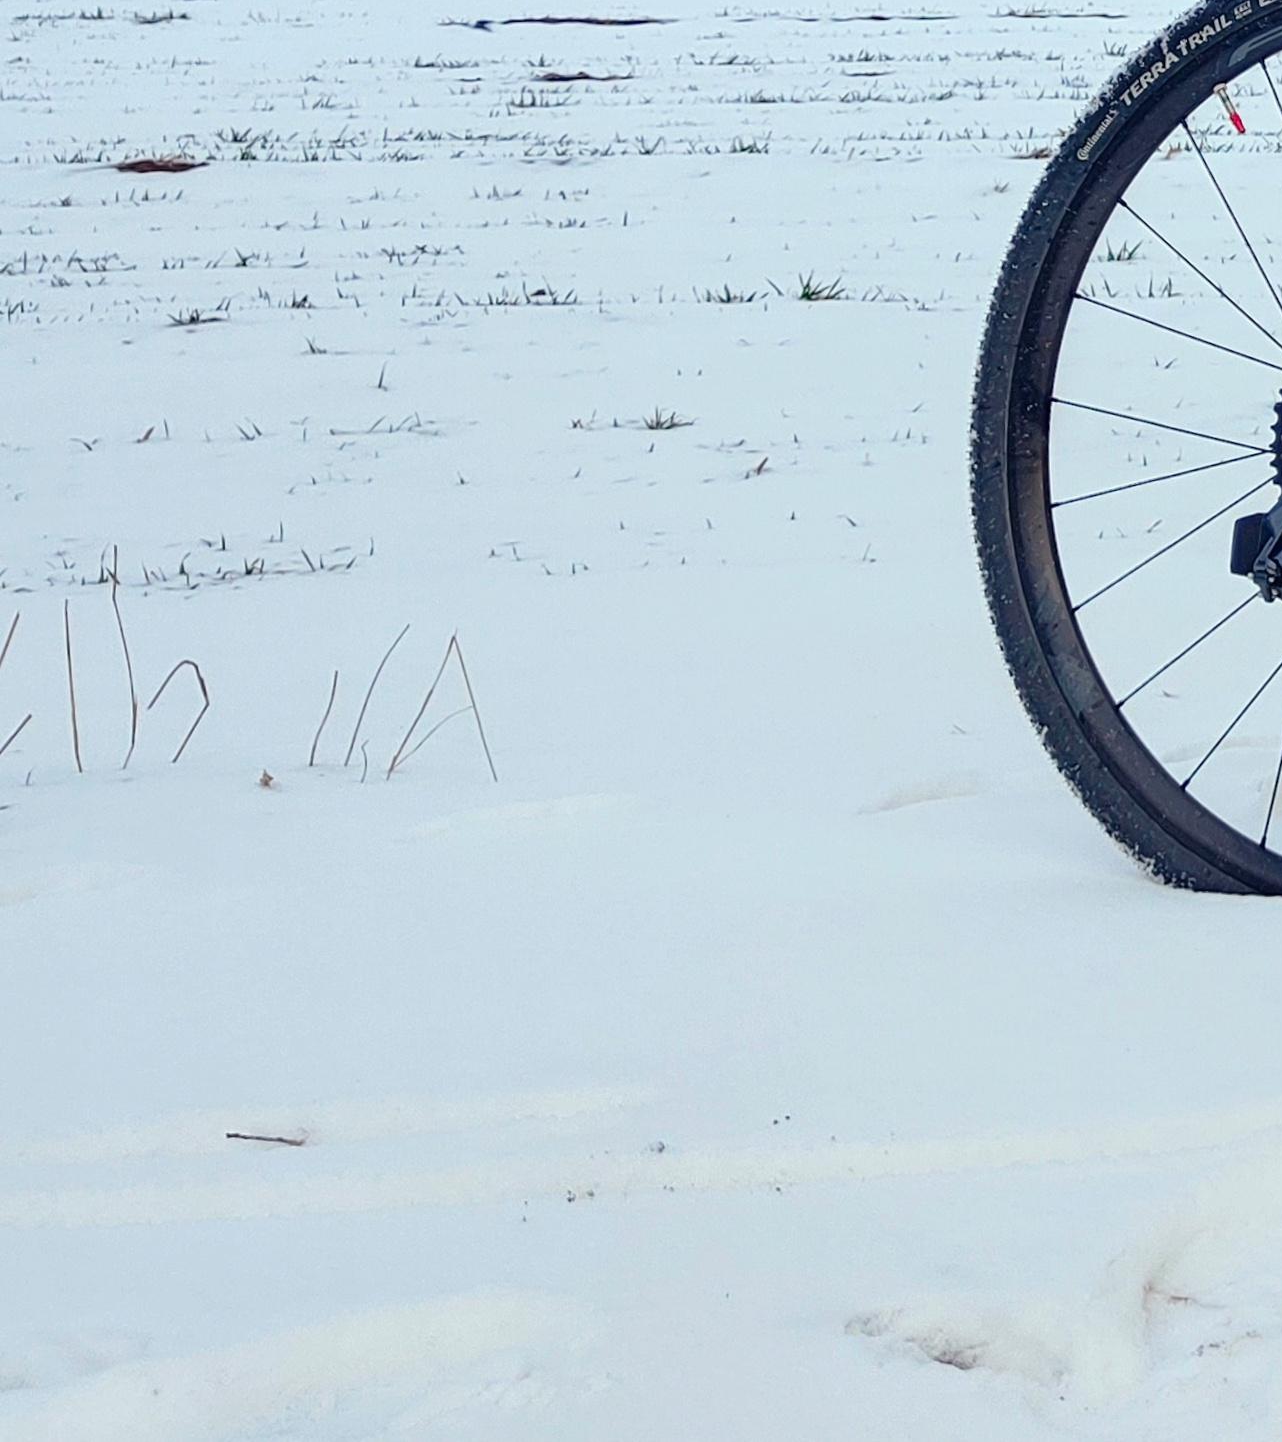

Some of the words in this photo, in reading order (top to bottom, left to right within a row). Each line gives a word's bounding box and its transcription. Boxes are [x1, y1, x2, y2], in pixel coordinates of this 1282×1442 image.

[1077, 111, 1117, 160] Continental
[1119, 52, 1180, 107] TERRA
[1176, 14, 1233, 57] TRAIL
